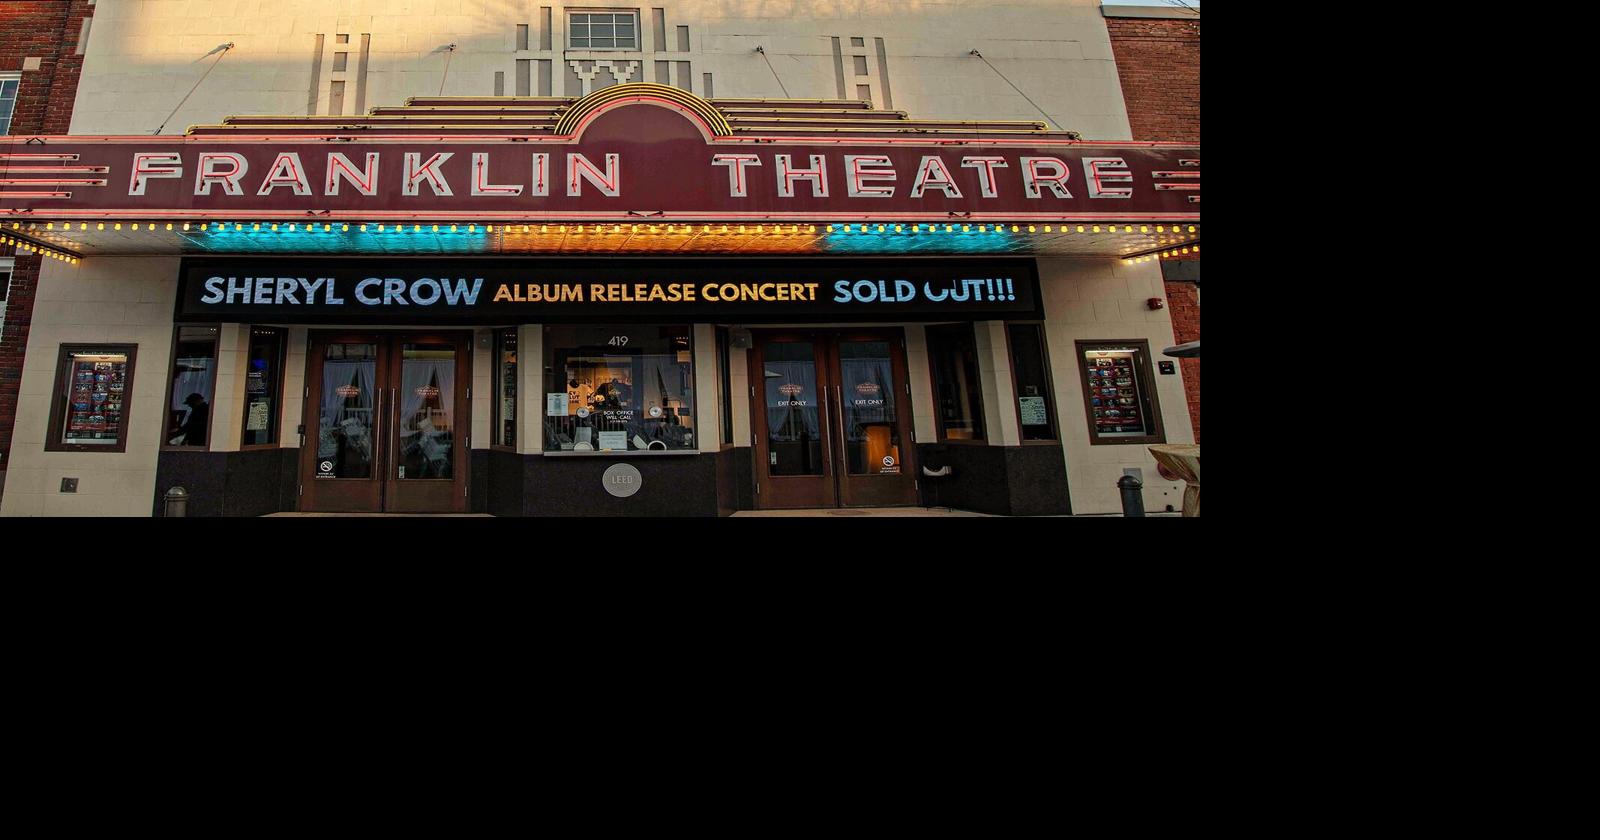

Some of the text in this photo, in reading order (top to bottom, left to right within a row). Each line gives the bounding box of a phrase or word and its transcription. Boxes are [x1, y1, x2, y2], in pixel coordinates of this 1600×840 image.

[128, 152, 1134, 199] FRANKLIN THEATRE
[200, 277, 344, 306] SHERYL
[354, 277, 484, 306] CROW
[493, 283, 584, 303] ALBUM
[590, 283, 696, 303] RELEASE
[701, 282, 819, 303] CONCERT
[833, 279, 916, 303] SOLD
[608, 336, 629, 346] 419
[612, 475, 633, 484] LEED
